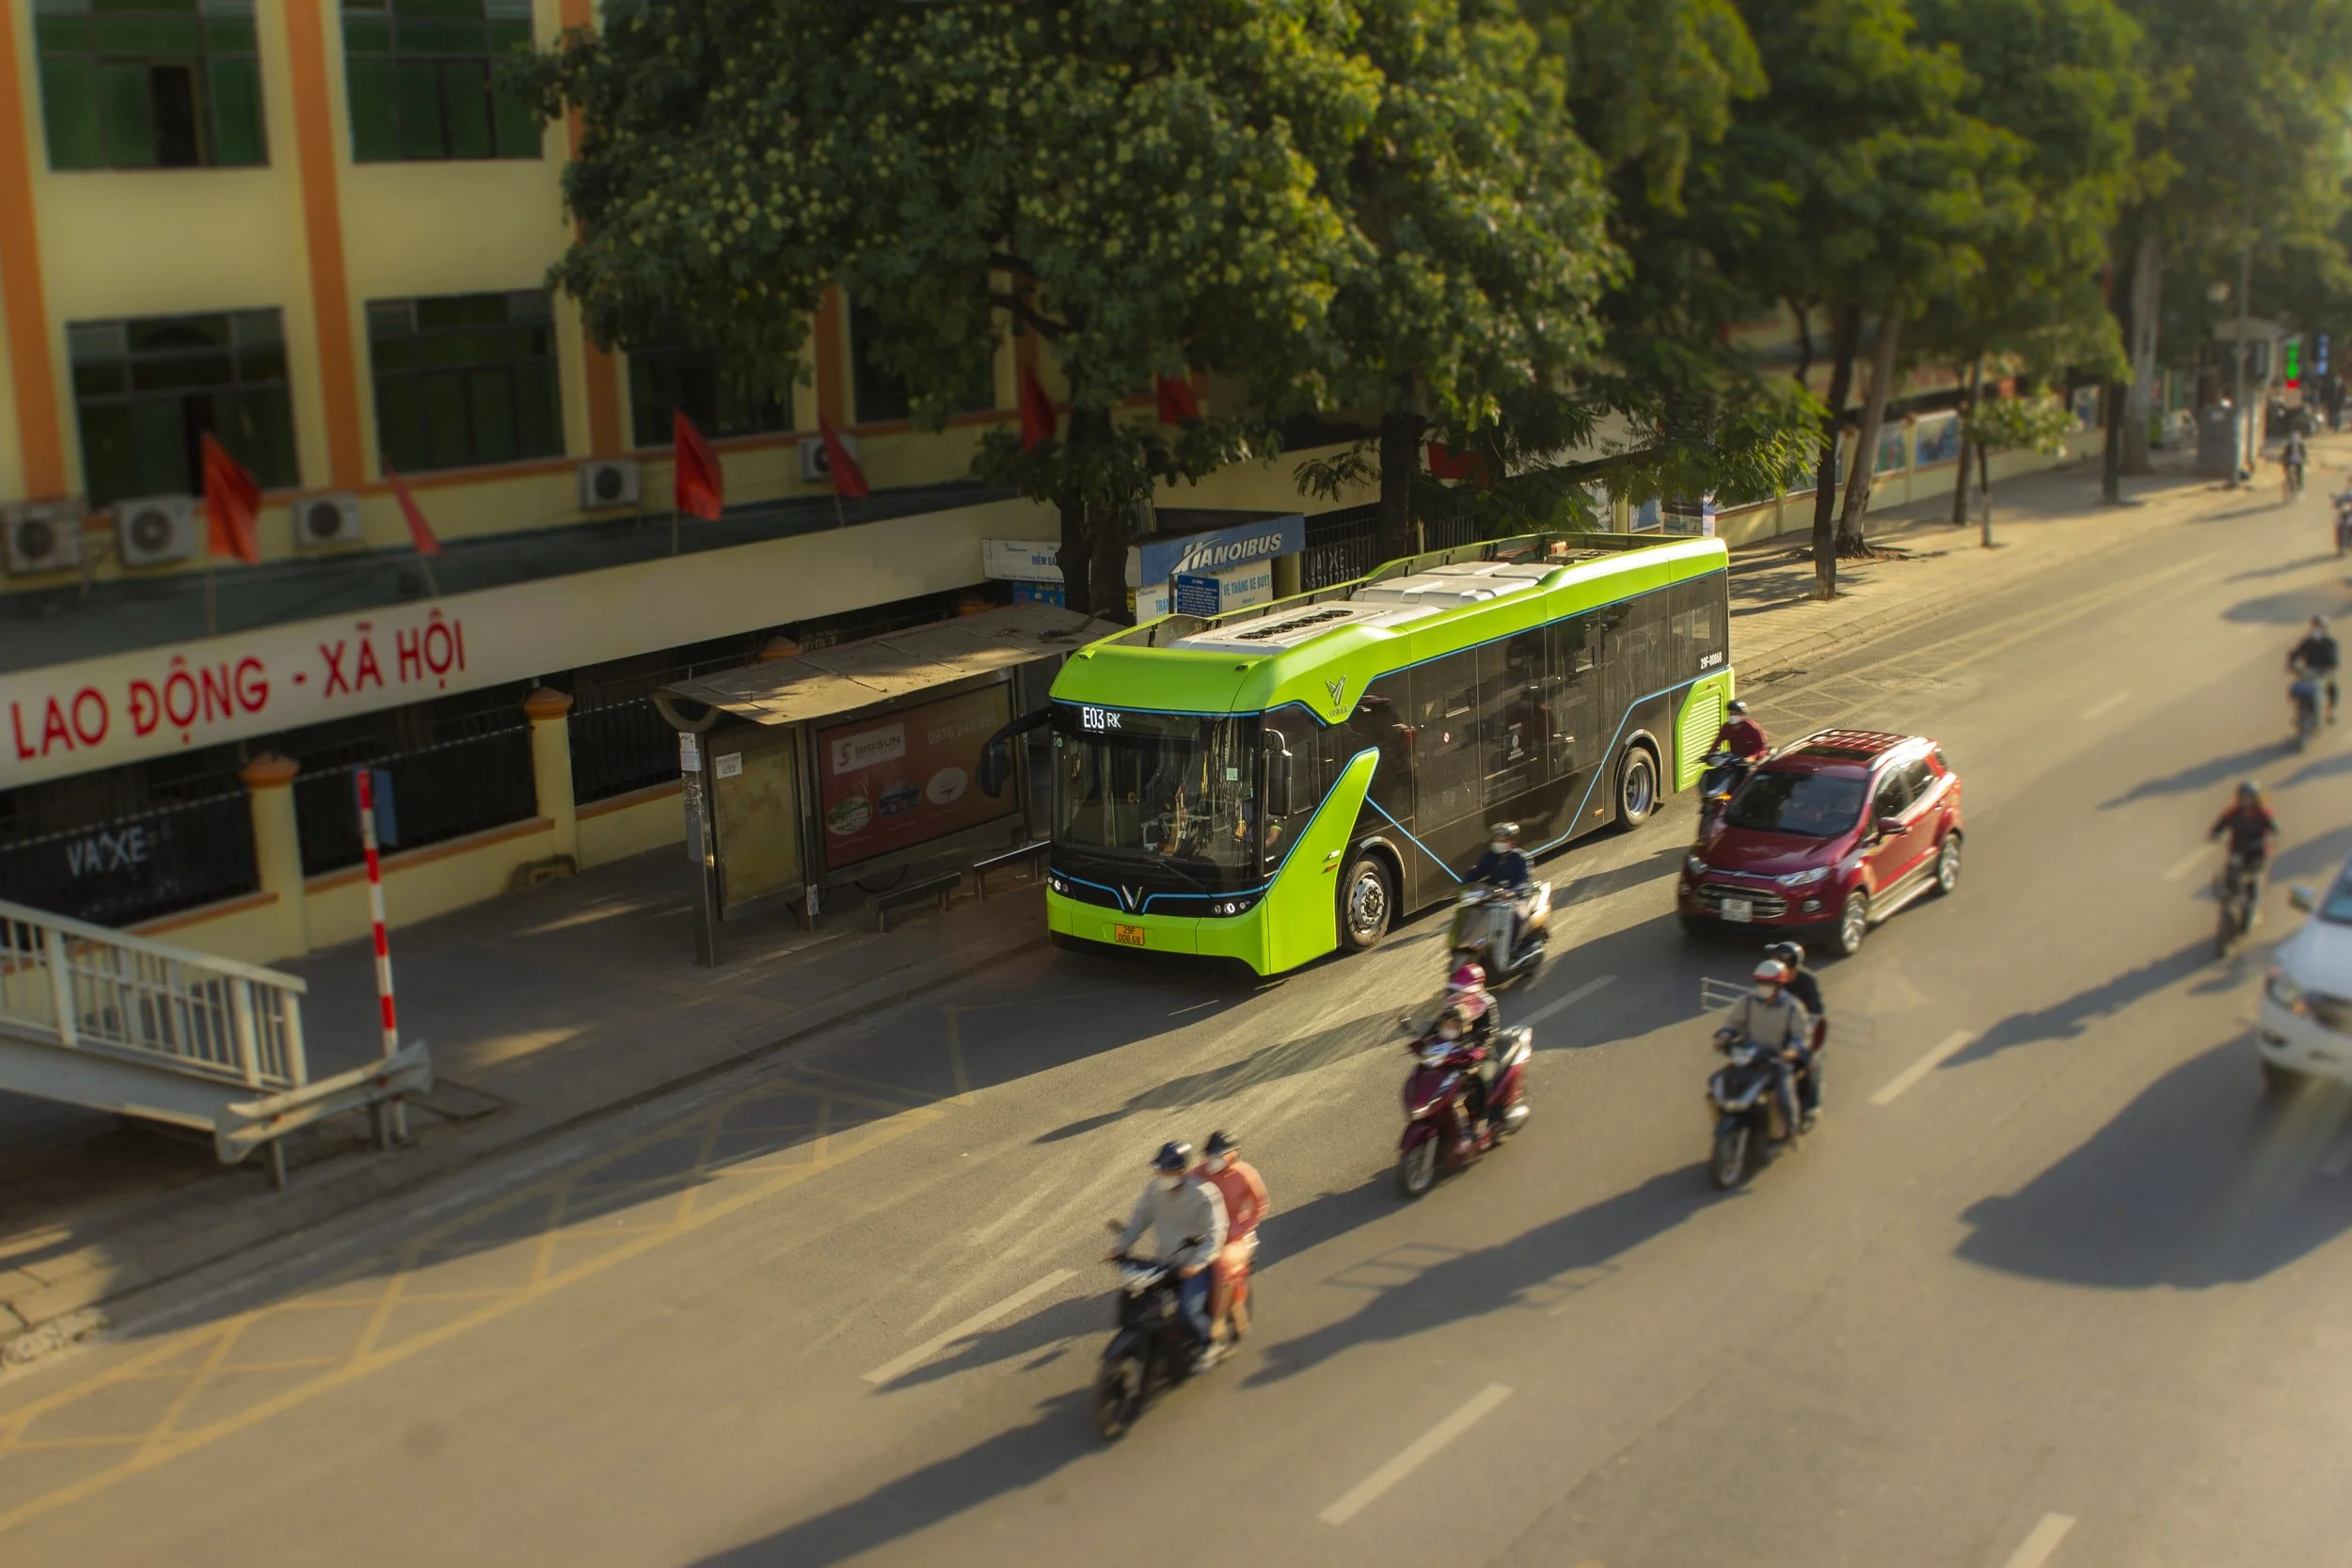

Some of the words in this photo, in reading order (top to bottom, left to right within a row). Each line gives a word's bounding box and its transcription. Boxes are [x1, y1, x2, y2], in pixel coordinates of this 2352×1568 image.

[1171, 532, 1282, 575] HANOIBUS
[1329, 548, 1344, 572] XE
[1249, 577, 1256, 591] XE
[10, 687, 110, 760] LAO
[128, 656, 270, 743] ĐỘNG
[318, 622, 383, 698] XÃ
[396, 609, 466, 689] HỘI
[1082, 706, 1104, 729] E03
